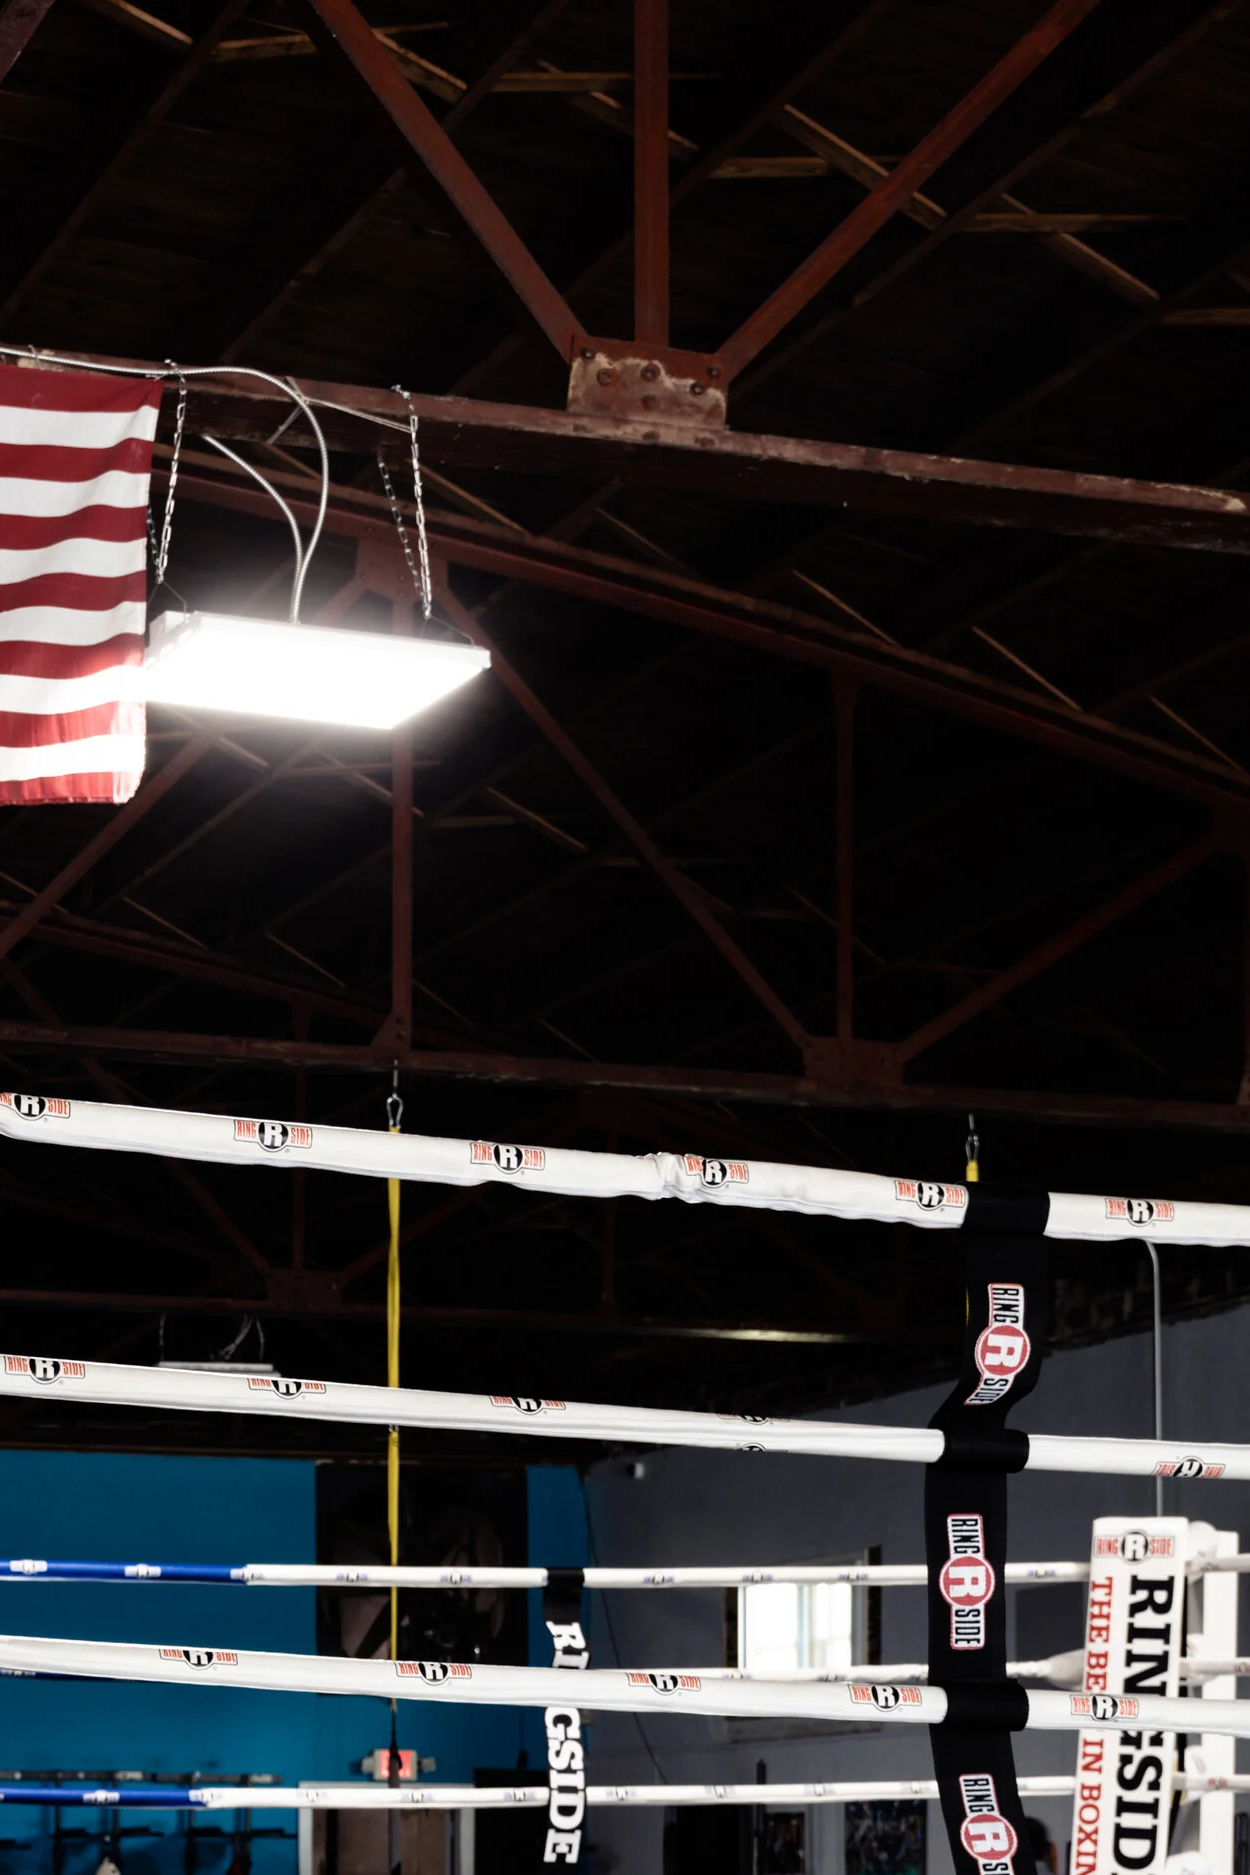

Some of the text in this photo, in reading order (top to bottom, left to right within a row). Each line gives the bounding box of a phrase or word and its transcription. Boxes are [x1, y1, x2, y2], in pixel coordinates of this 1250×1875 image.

[47, 1097, 68, 1115] SIDE
[264, 1122, 282, 1147] R
[498, 1145, 519, 1170] R
[707, 1160, 724, 1184] R
[922, 1183, 941, 1207] R
[1132, 1200, 1150, 1224] R
[991, 1287, 1020, 1324] RING
[984, 1332, 1025, 1367] R
[1123, 1534, 1148, 1560] R
[949, 1517, 987, 1645] RING R SIDE
[1090, 1576, 1113, 1644] THE
[877, 1686, 895, 1709] R
[1096, 1696, 1115, 1720] R
[544, 1621, 590, 1863] RIGSIDE
[1082, 1738, 1104, 1774] IN
[963, 1777, 995, 1814] RING
[967, 1821, 1011, 1854] R
